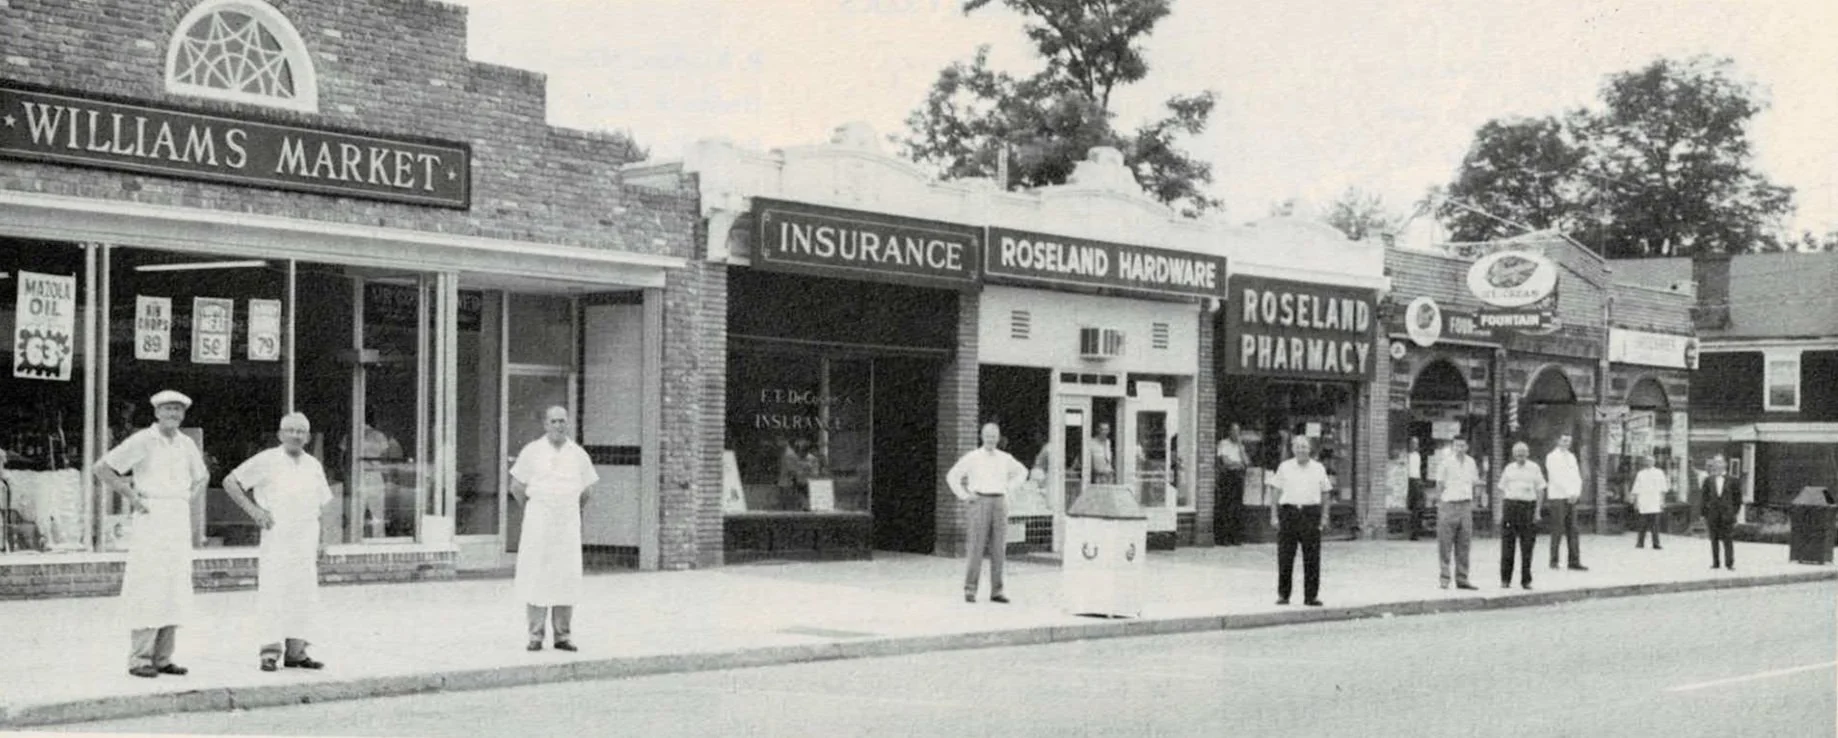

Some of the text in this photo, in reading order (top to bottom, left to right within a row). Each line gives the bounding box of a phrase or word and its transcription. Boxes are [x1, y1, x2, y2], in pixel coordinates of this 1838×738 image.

[22, 100, 441, 192] WILLIAMS MARKET
[779, 221, 963, 271] INSURANCE
[1001, 236, 1216, 289] ROSELAND HARDWARE
[29, 298, 62, 317] OIL
[1243, 288, 1370, 332] ROSELAND
[1480, 313, 1540, 326] FOUNTAIN
[142, 334, 162, 353] 89
[257, 336, 275, 354] 79
[1241, 333, 1370, 374] PHARMACY
[756, 414, 843, 430] INSURANE
